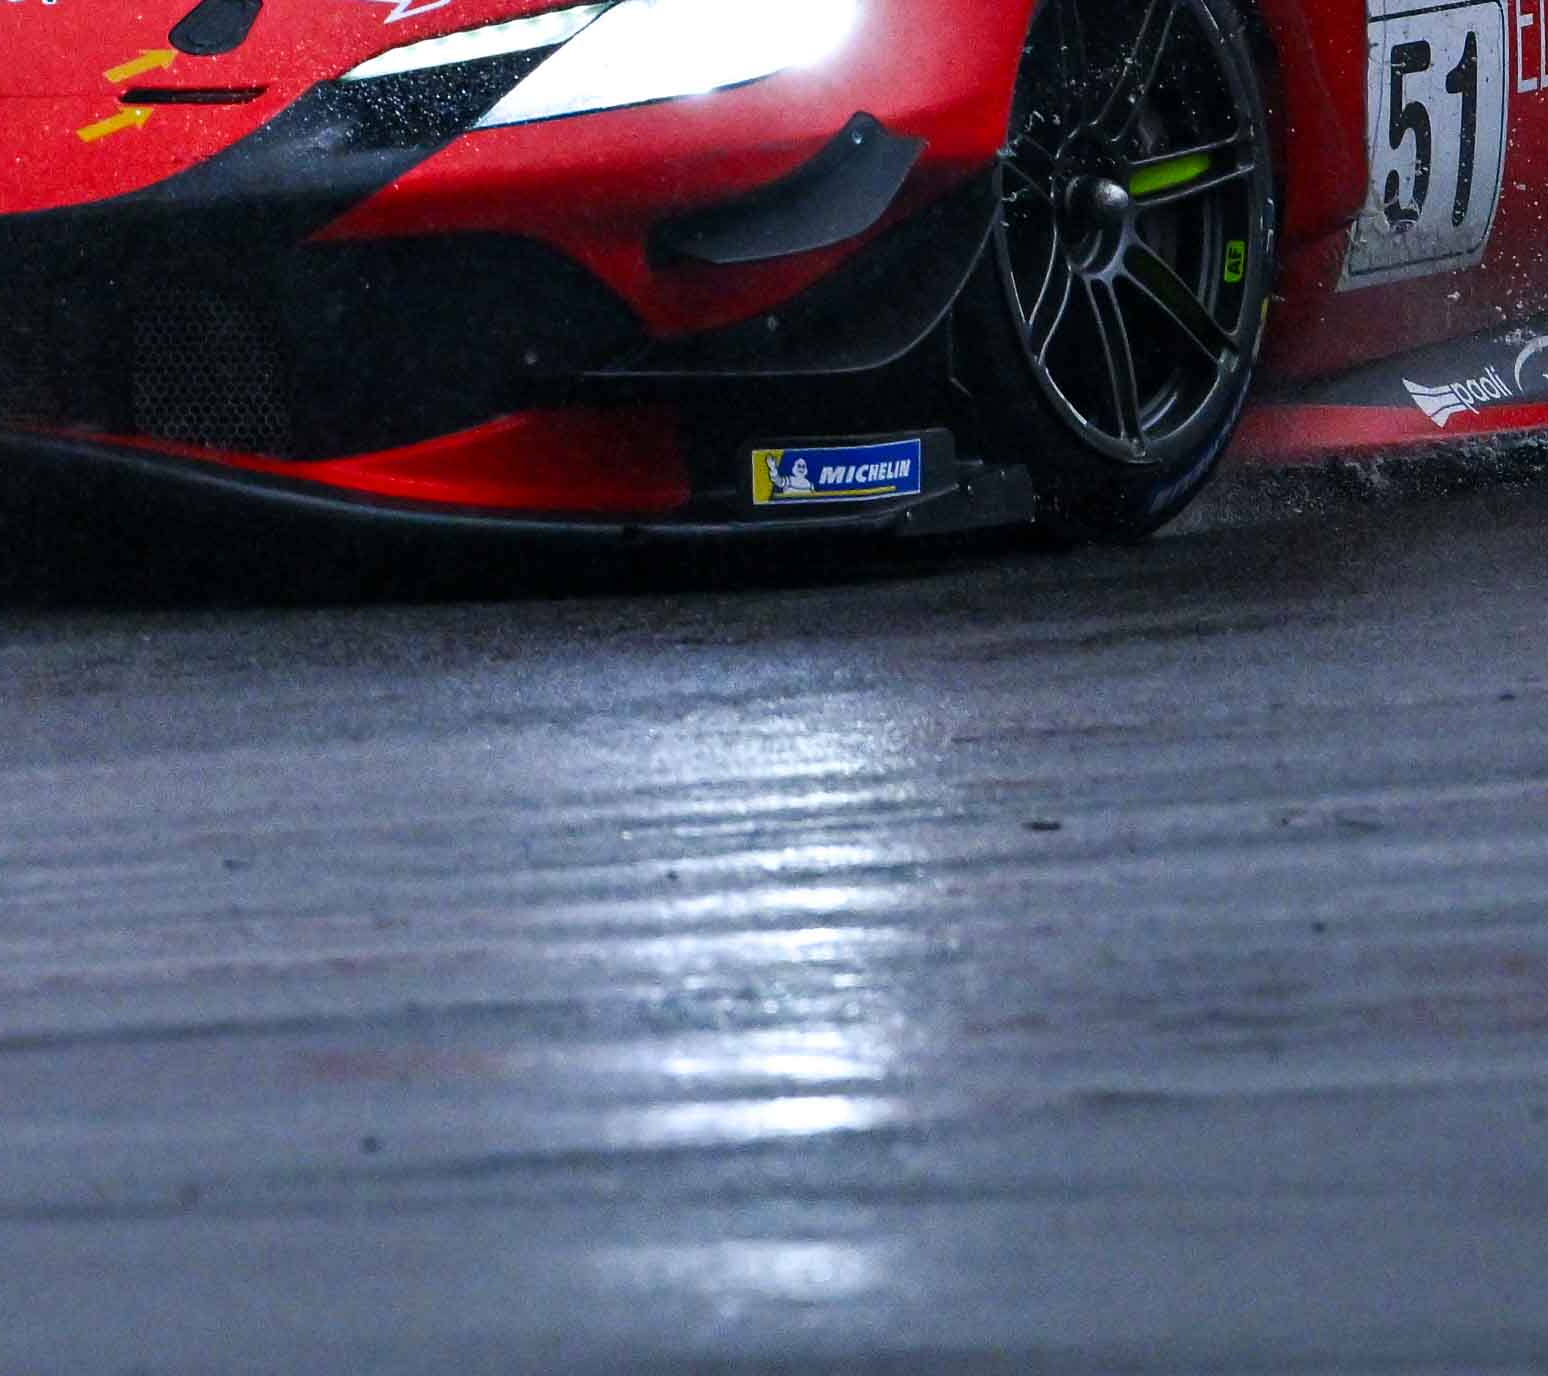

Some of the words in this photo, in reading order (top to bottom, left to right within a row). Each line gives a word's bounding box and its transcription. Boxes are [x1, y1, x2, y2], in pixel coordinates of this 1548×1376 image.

[1383, 30, 1479, 234] 51
[1450, 364, 1514, 415] paoli
[818, 458, 893, 485] MICHELIN
